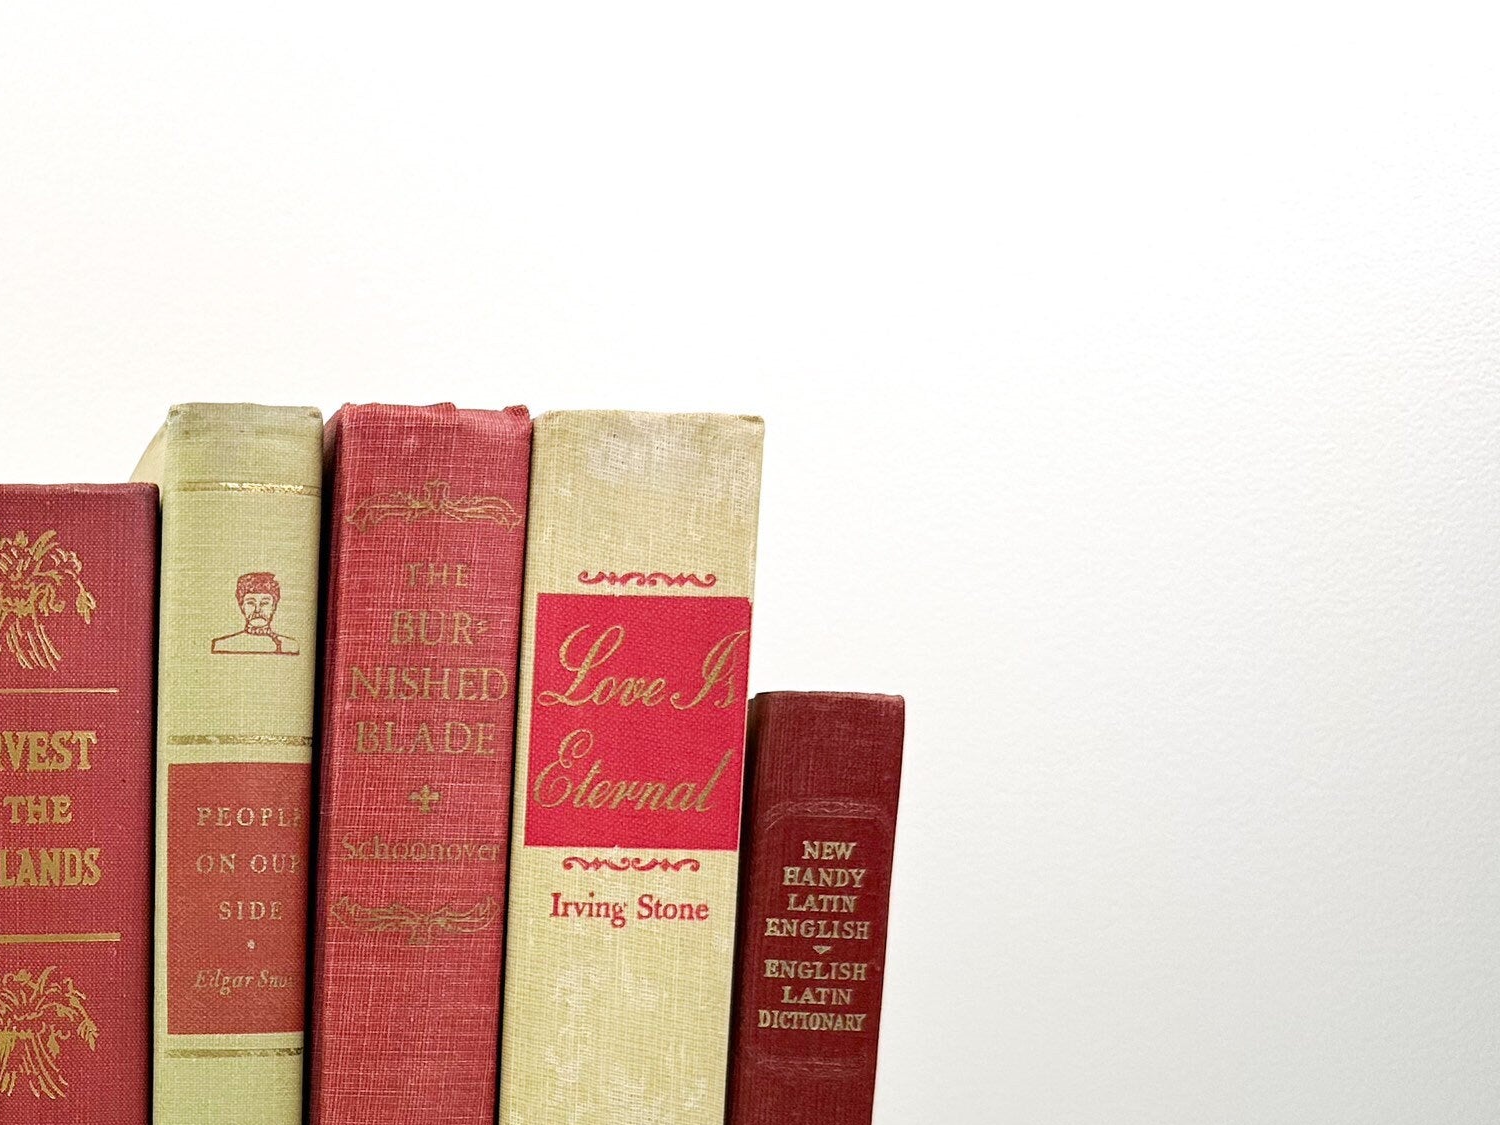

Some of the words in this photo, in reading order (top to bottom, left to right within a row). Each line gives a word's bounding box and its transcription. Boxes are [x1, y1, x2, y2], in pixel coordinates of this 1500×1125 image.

[404, 561, 471, 589] THE
[538, 622, 667, 709] Love
[670, 628, 750, 712] Is
[346, 666, 509, 702] NISHED
[354, 721, 497, 756] BLADE
[531, 728, 735, 815] Eternal
[3, 795, 73, 824] THE
[341, 833, 500, 863] Schoonover
[801, 840, 858, 860] NEW
[196, 853, 236, 874] ON
[782, 866, 867, 888] HANDY
[218, 901, 283, 921] SIDE
[549, 893, 626, 929] Irving
[636, 894, 709, 922] Stone
[786, 893, 859, 912] LATIN
[764, 917, 870, 940] ENGLISH
[763, 959, 868, 981] ENGLISH
[195, 969, 253, 997] Edgar
[781, 985, 853, 1005] LATIN
[757, 1009, 867, 1032] DICTIONARY
